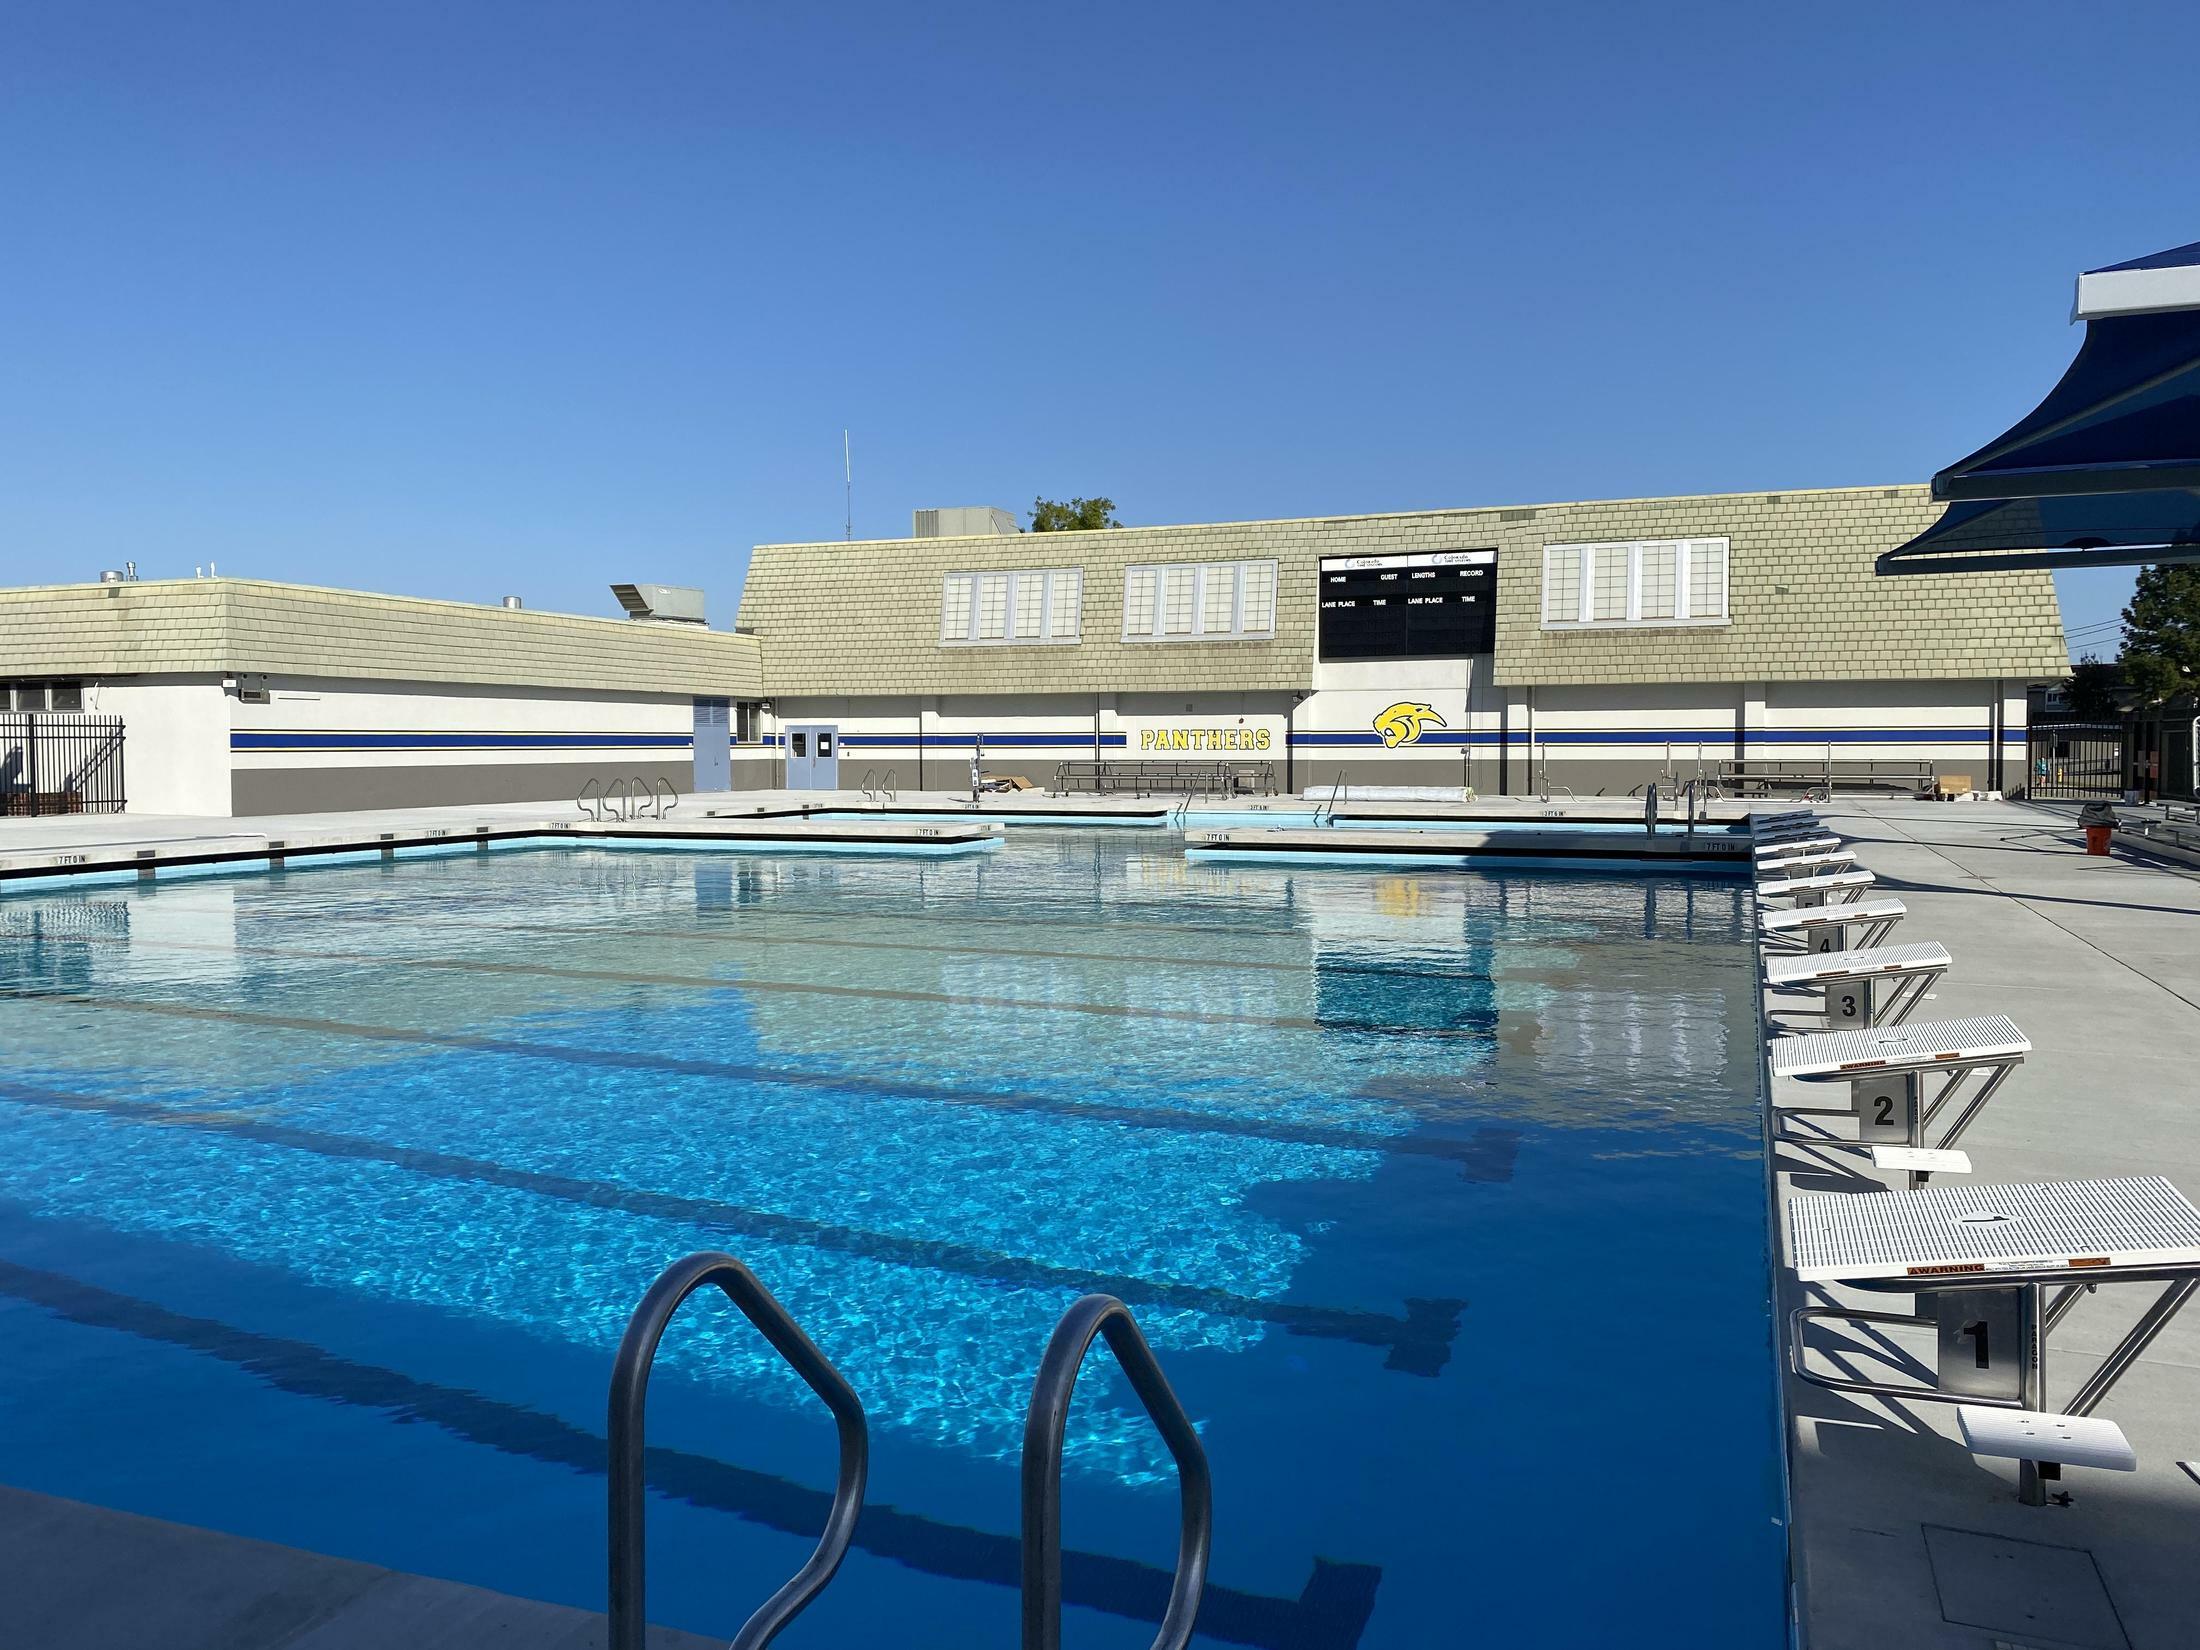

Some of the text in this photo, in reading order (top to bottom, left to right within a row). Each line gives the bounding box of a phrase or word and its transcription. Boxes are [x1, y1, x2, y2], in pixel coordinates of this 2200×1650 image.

[1411, 571, 1435, 579] LENGTHS
[1141, 729, 1270, 751] PANTHERS
[64, 856, 71, 864] FT
[79, 855, 85, 863] IN
[1820, 939, 1831, 952] 4
[1842, 995, 1856, 1017] 3
[1874, 1096, 1894, 1126] 2
[1918, 1264, 1984, 1274] WARNING
[1964, 1321, 1989, 1369] 1
